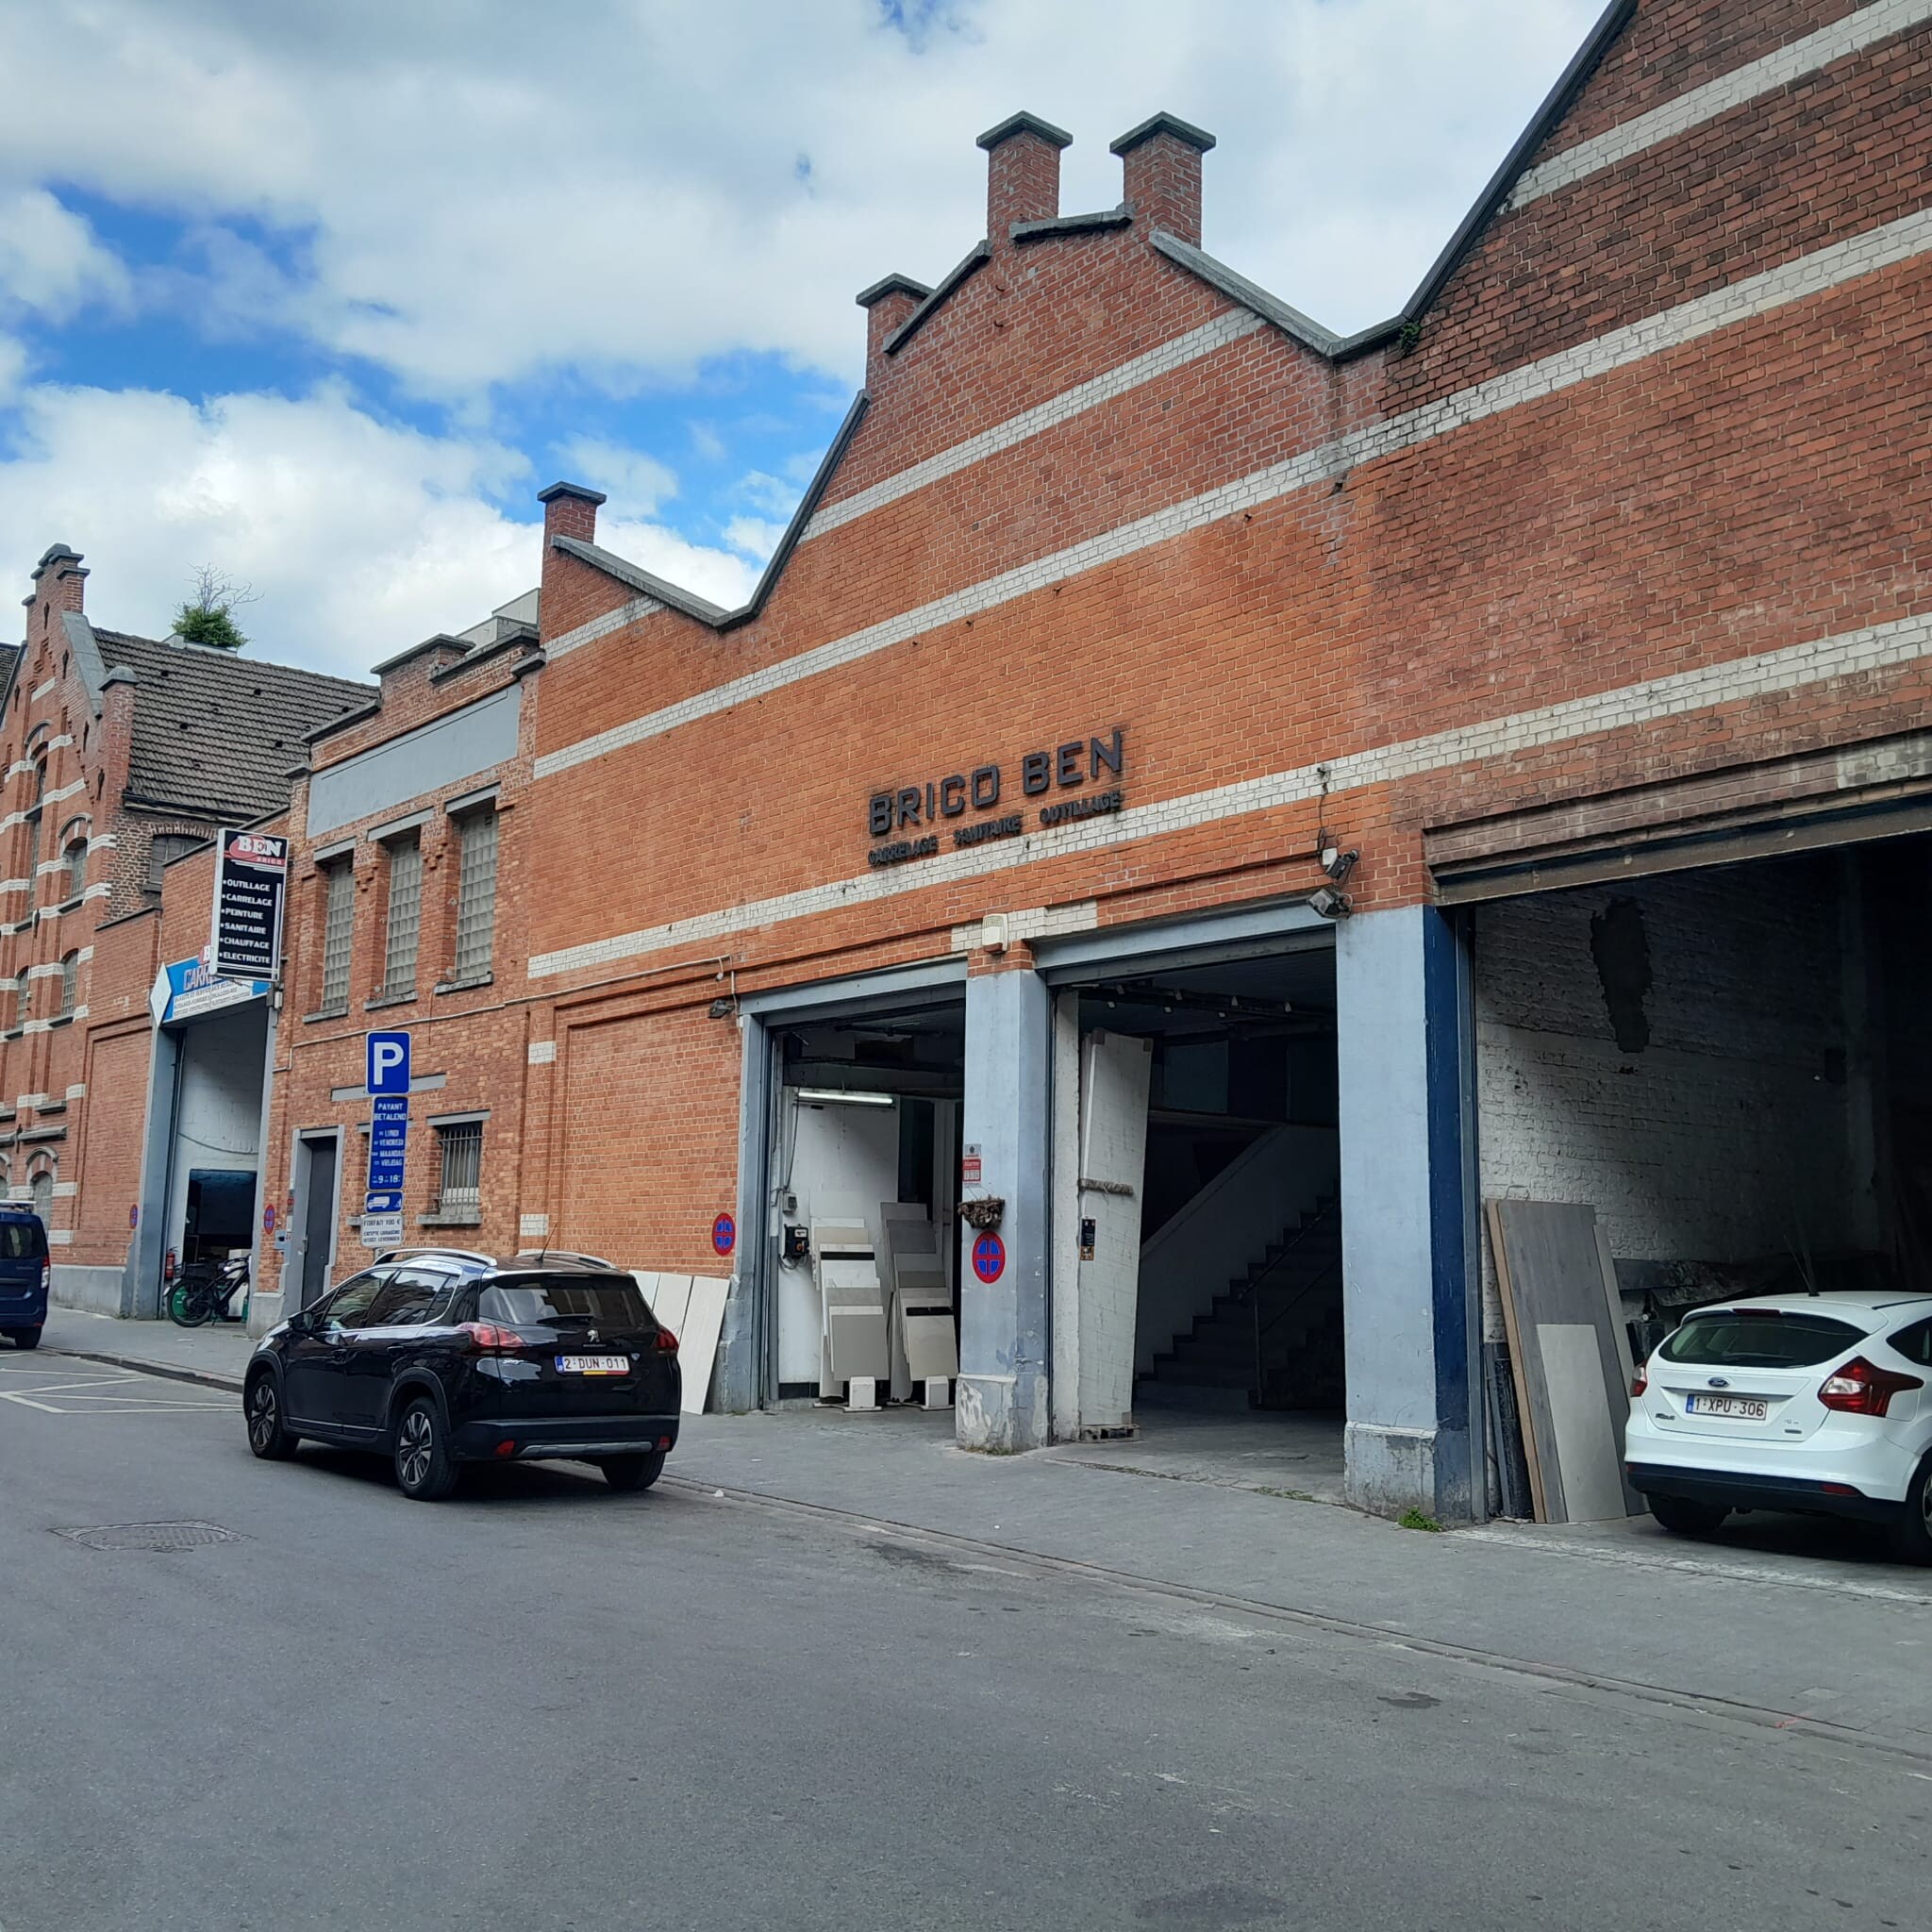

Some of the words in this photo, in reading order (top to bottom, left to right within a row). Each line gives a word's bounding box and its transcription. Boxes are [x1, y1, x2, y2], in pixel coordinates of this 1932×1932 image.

[869, 765, 1000, 835] BRICO
[1023, 730, 1123, 794] BEN
[868, 835, 940, 868] CARRELAGE
[953, 814, 1023, 845] SANITAIRE
[1040, 791, 1123, 824] OUTILLAGE
[238, 836, 282, 857] BEN
[226, 878, 271, 891] OUTILLAGE
[225, 893, 273, 907] CARRELAGE
[225, 908, 263, 920] PEINTURE
[225, 922, 267, 935] SANITAIRE
[224, 937, 270, 950] CHAUFFAGE
[223, 952, 271, 964] ELECTRICITE
[374, 1042, 404, 1085] P
[374, 1112, 407, 1121] BETALEND
